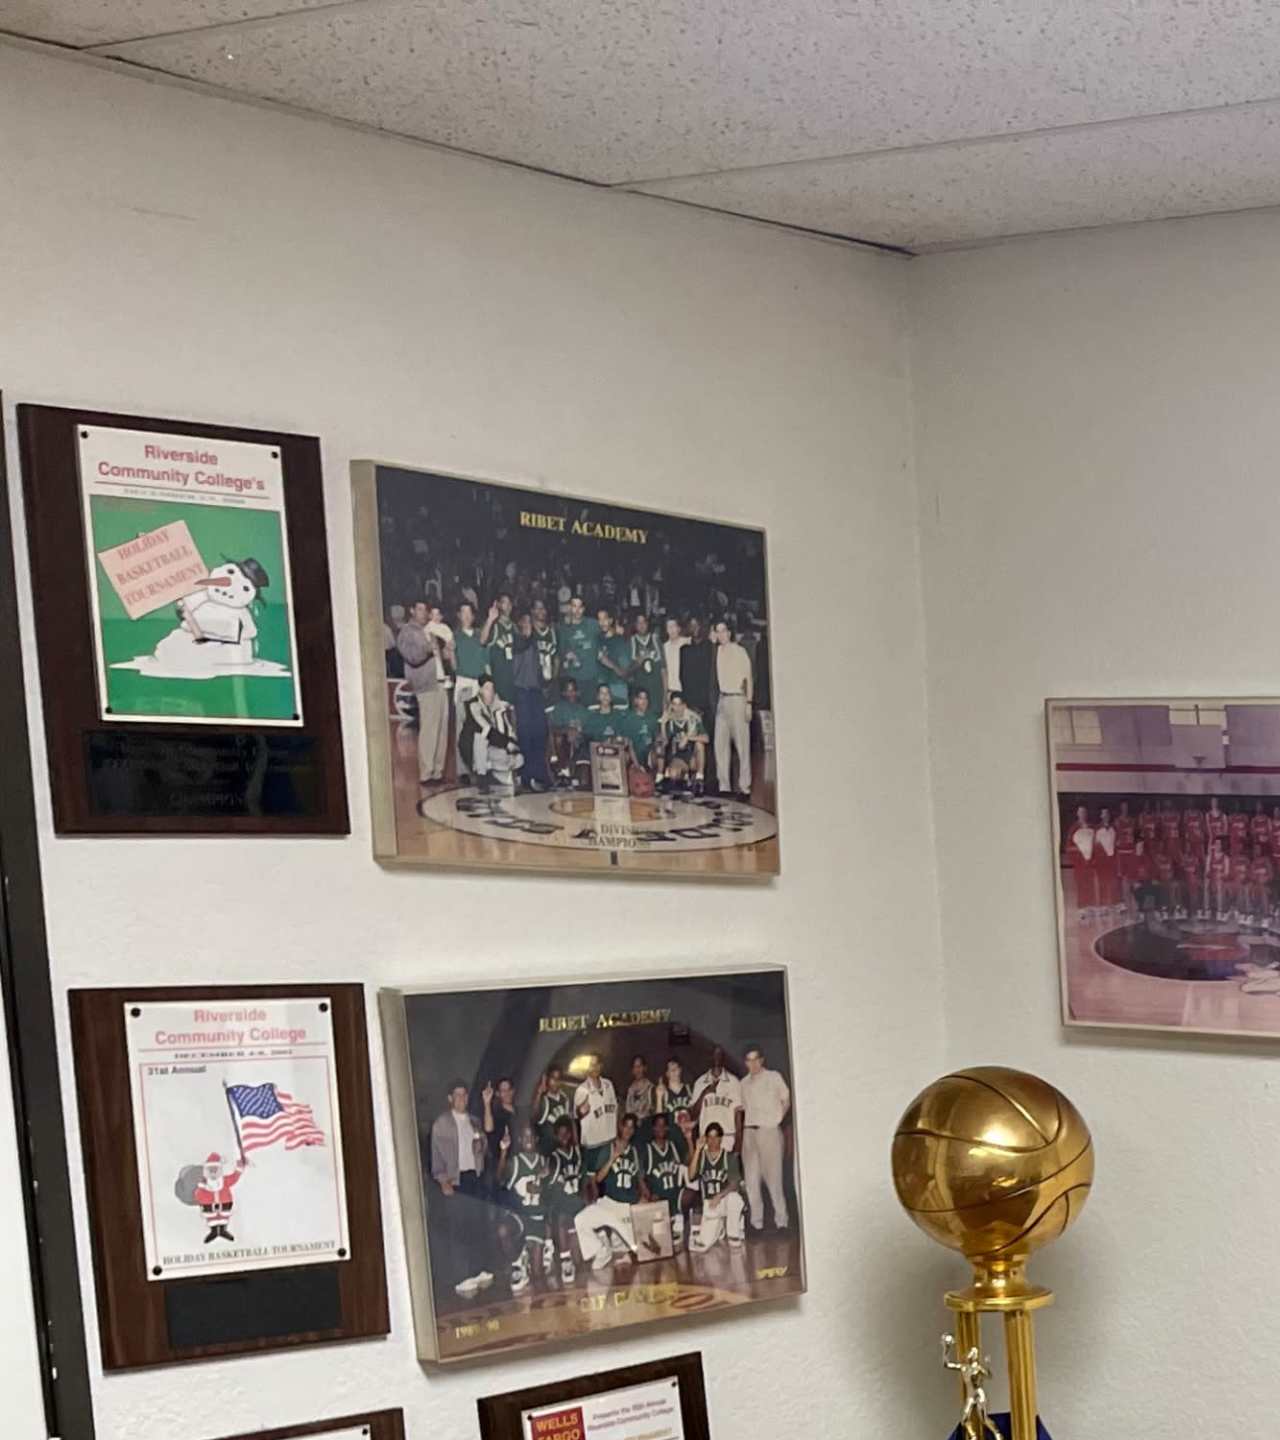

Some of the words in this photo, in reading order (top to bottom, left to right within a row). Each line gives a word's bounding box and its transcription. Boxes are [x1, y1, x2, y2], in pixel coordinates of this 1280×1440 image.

[144, 445, 218, 465] Riverside
[98, 462, 189, 486] Community
[195, 472, 265, 491] College's
[520, 511, 565, 533] RIBET
[570, 520, 649, 544] ACADEMY
[118, 528, 170, 560] HOLIDAY
[116, 546, 192, 584] BASKETBALL
[123, 564, 204, 605] TOURNAMENT
[194, 1009, 267, 1023] Riverside
[539, 1014, 589, 1032] RIBET
[596, 1008, 672, 1029] ACADEMY
[155, 1030, 244, 1045] Community
[250, 1028, 306, 1043] College
[171, 1065, 206, 1075] Annual
[163, 1253, 205, 1265] HOLIDAY
[208, 1247, 268, 1261] BASKETBALL
[272, 1240, 335, 1255] TOURNAMENT
[536, 1413, 578, 1433] WELLS
